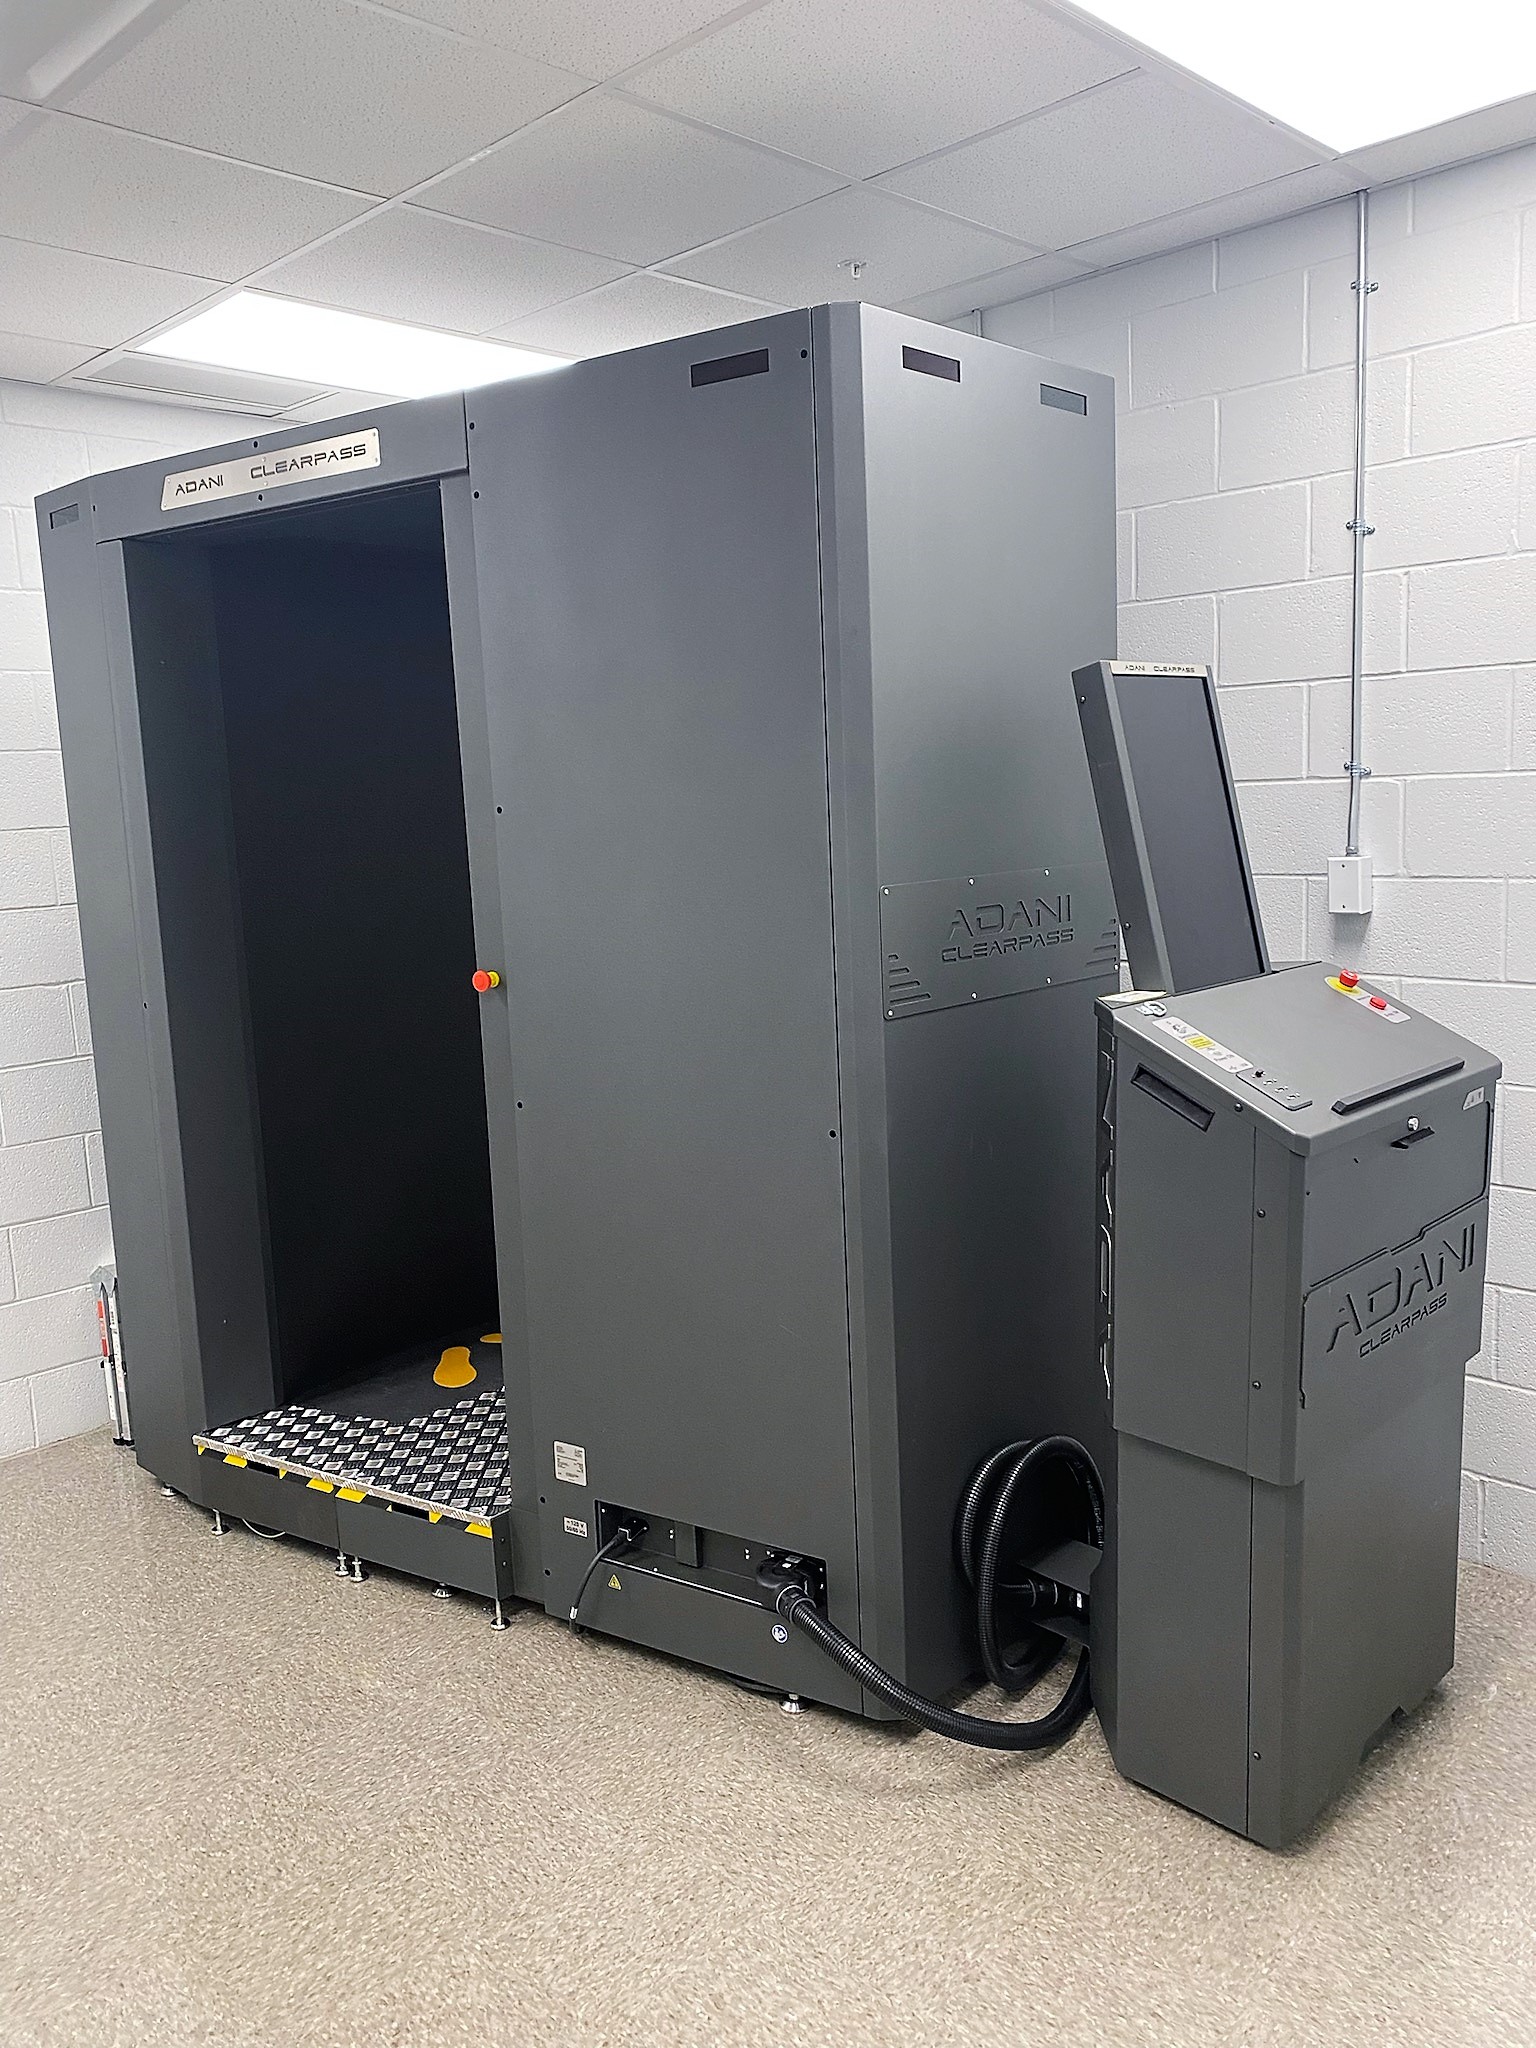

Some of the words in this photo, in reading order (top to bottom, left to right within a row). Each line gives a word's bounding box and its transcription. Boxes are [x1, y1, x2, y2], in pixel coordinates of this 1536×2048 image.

[175, 474, 224, 496] ADANI
[250, 443, 367, 479] CLEARPASS
[1153, 665, 1195, 673] CLEARPASS
[949, 894, 1072, 941] ADANI
[942, 928, 1074, 963] CLEARPASS
[1326, 1223, 1475, 1353] ADANI
[1359, 1292, 1448, 1358] CLEARPASS
